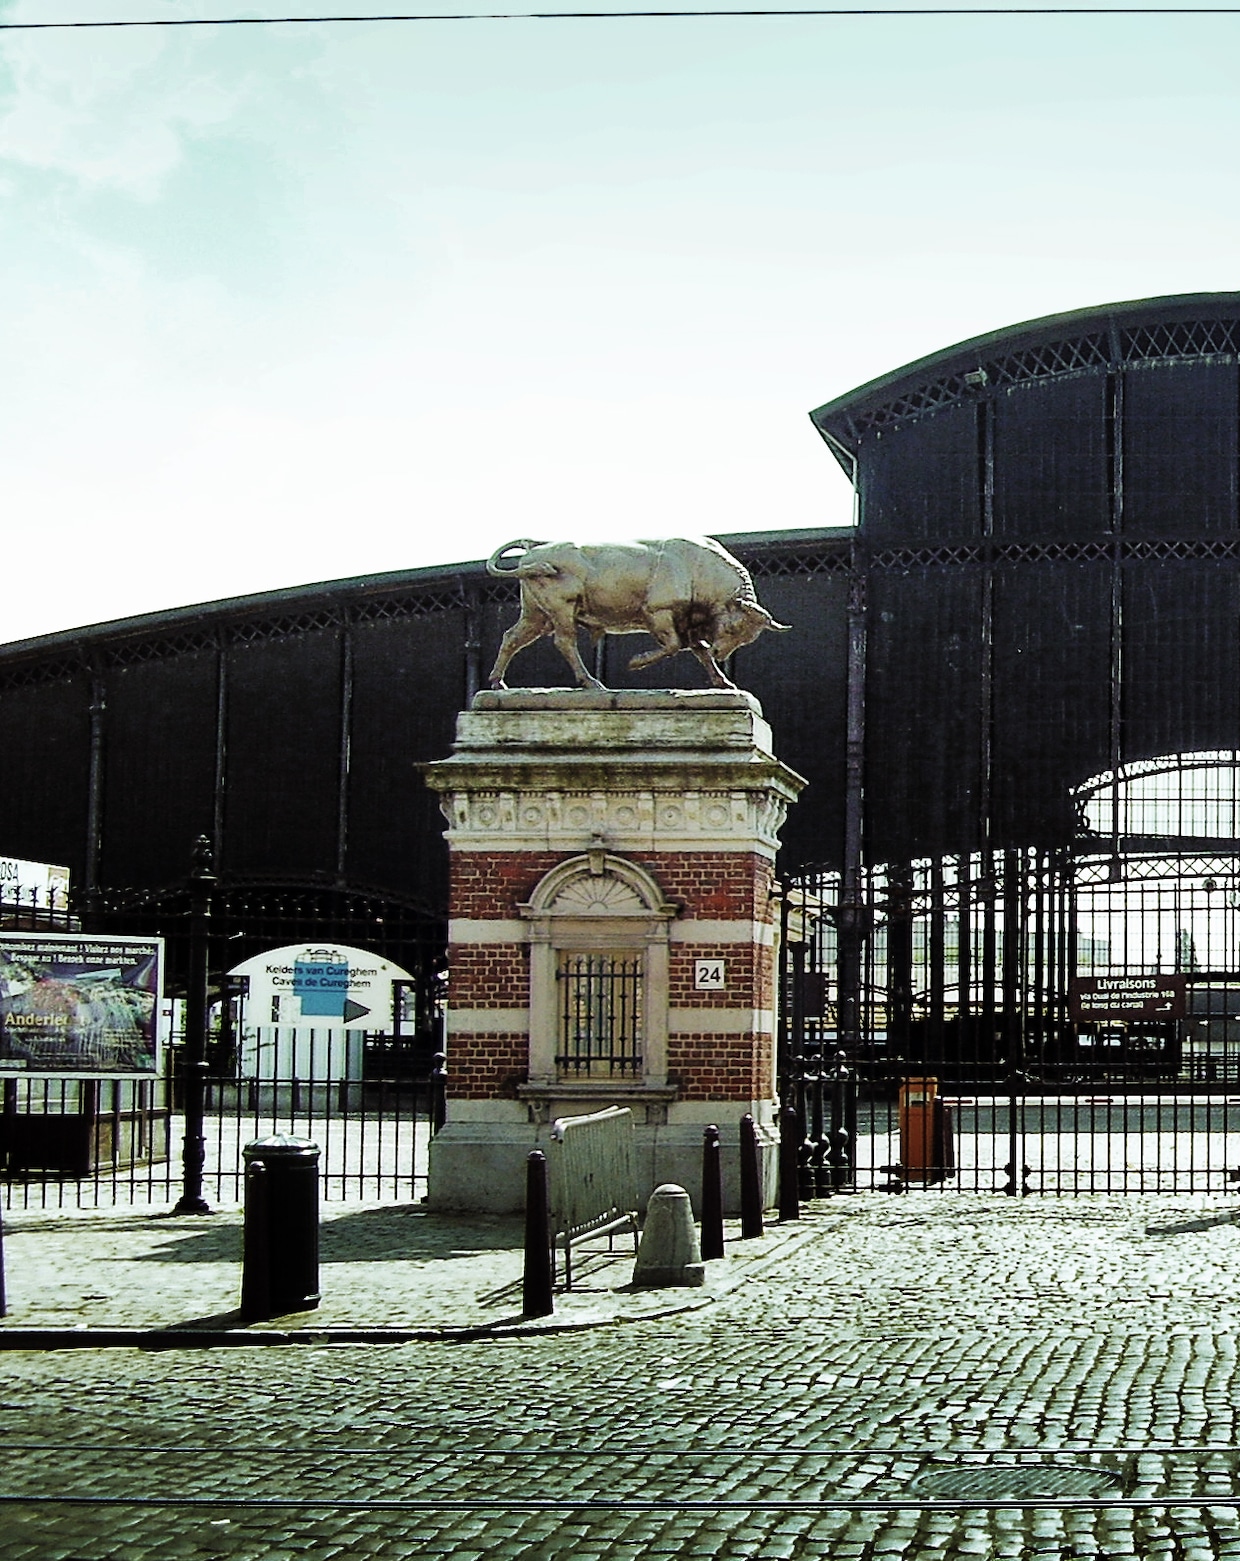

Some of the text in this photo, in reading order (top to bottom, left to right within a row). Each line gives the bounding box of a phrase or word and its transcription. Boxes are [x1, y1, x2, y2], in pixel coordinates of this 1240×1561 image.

[266, 965, 377, 977] Kelders van Cureghem
[698, 967, 721, 983] 24
[272, 977, 371, 988] Caves de Cureghem
[1097, 978, 1156, 990] Livraisons
[1110, 992, 1120, 1000] de
